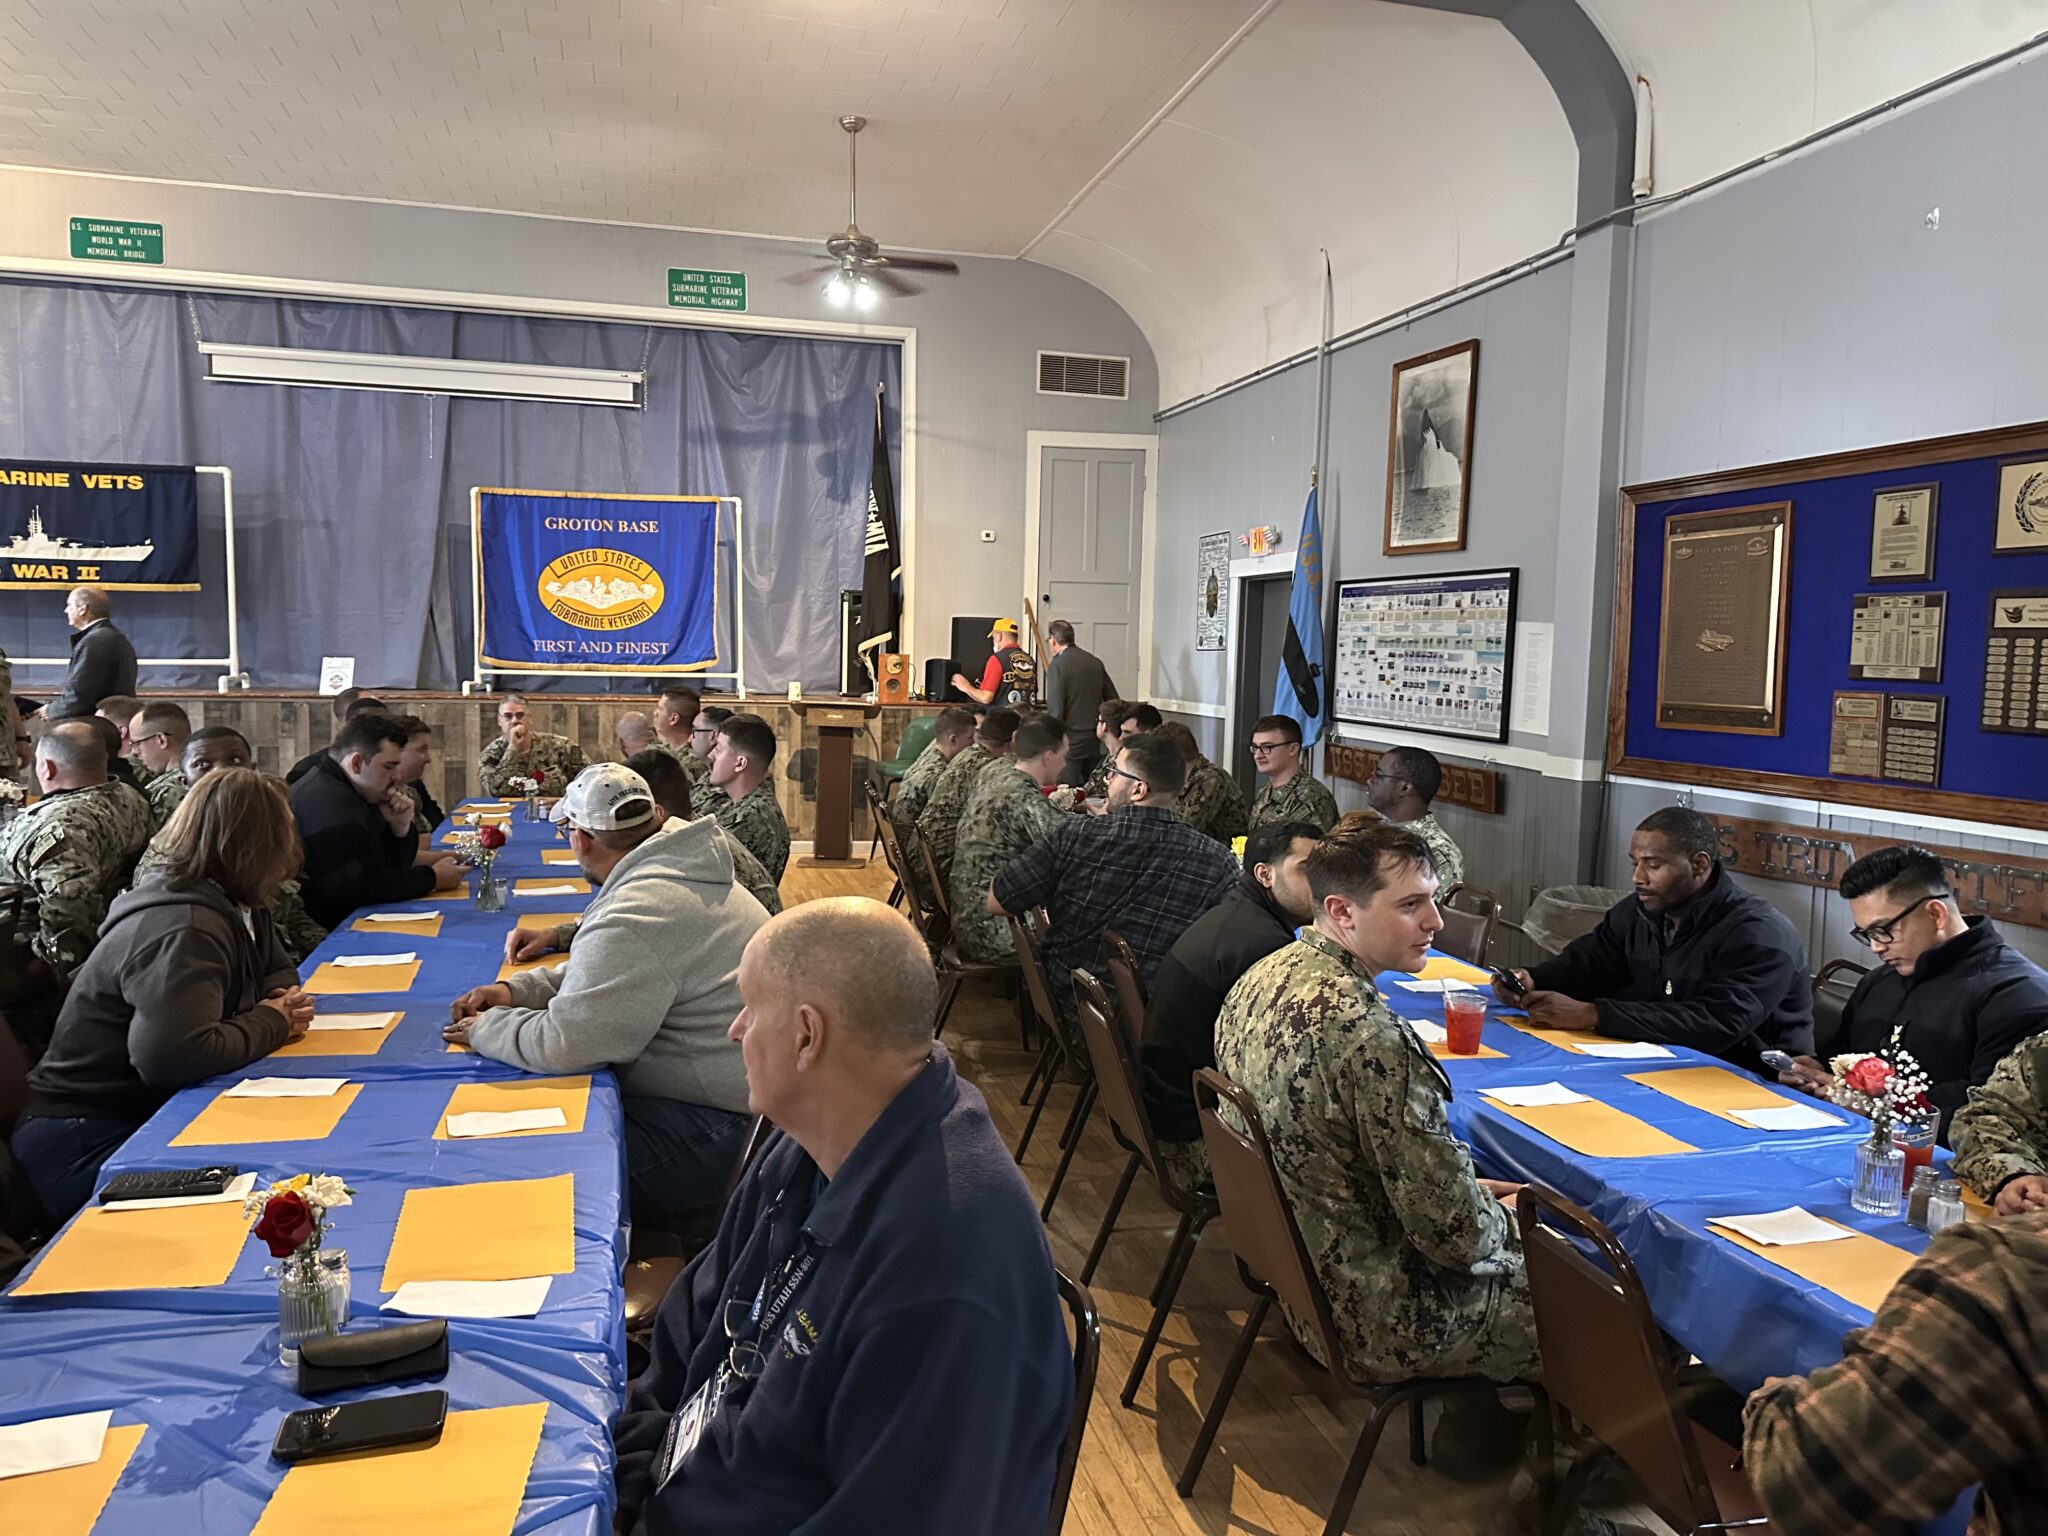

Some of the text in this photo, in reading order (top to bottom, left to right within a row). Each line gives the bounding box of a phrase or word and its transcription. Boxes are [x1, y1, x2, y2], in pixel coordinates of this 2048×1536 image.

[71, 222, 161, 237] U.S. SUBMARINE VETERANS
[91, 236, 142, 247] WORLD WAR II
[87, 247, 146, 259] MEMORIAL BRIDGE
[682, 273, 731, 284] UNITED STATES
[672, 284, 743, 297] SUBMARINE VETERANS
[674, 295, 738, 306] MEMORIAL HIGHWAY
[81, 474, 144, 490] VETS
[544, 516, 659, 534] GROTON BASE
[559, 550, 645, 573] UNITED STATES
[12, 563, 69, 580] WAR
[77, 566, 101, 581] II
[552, 603, 650, 629] SUBMARINE VETERANS
[532, 639, 670, 656] FIRST AND FINEST
[1330, 746, 1365, 775] USS
[760, 1311, 777, 1330] USS
[770, 1285, 793, 1314] UTAH
[788, 1254, 815, 1291] SSN-801
